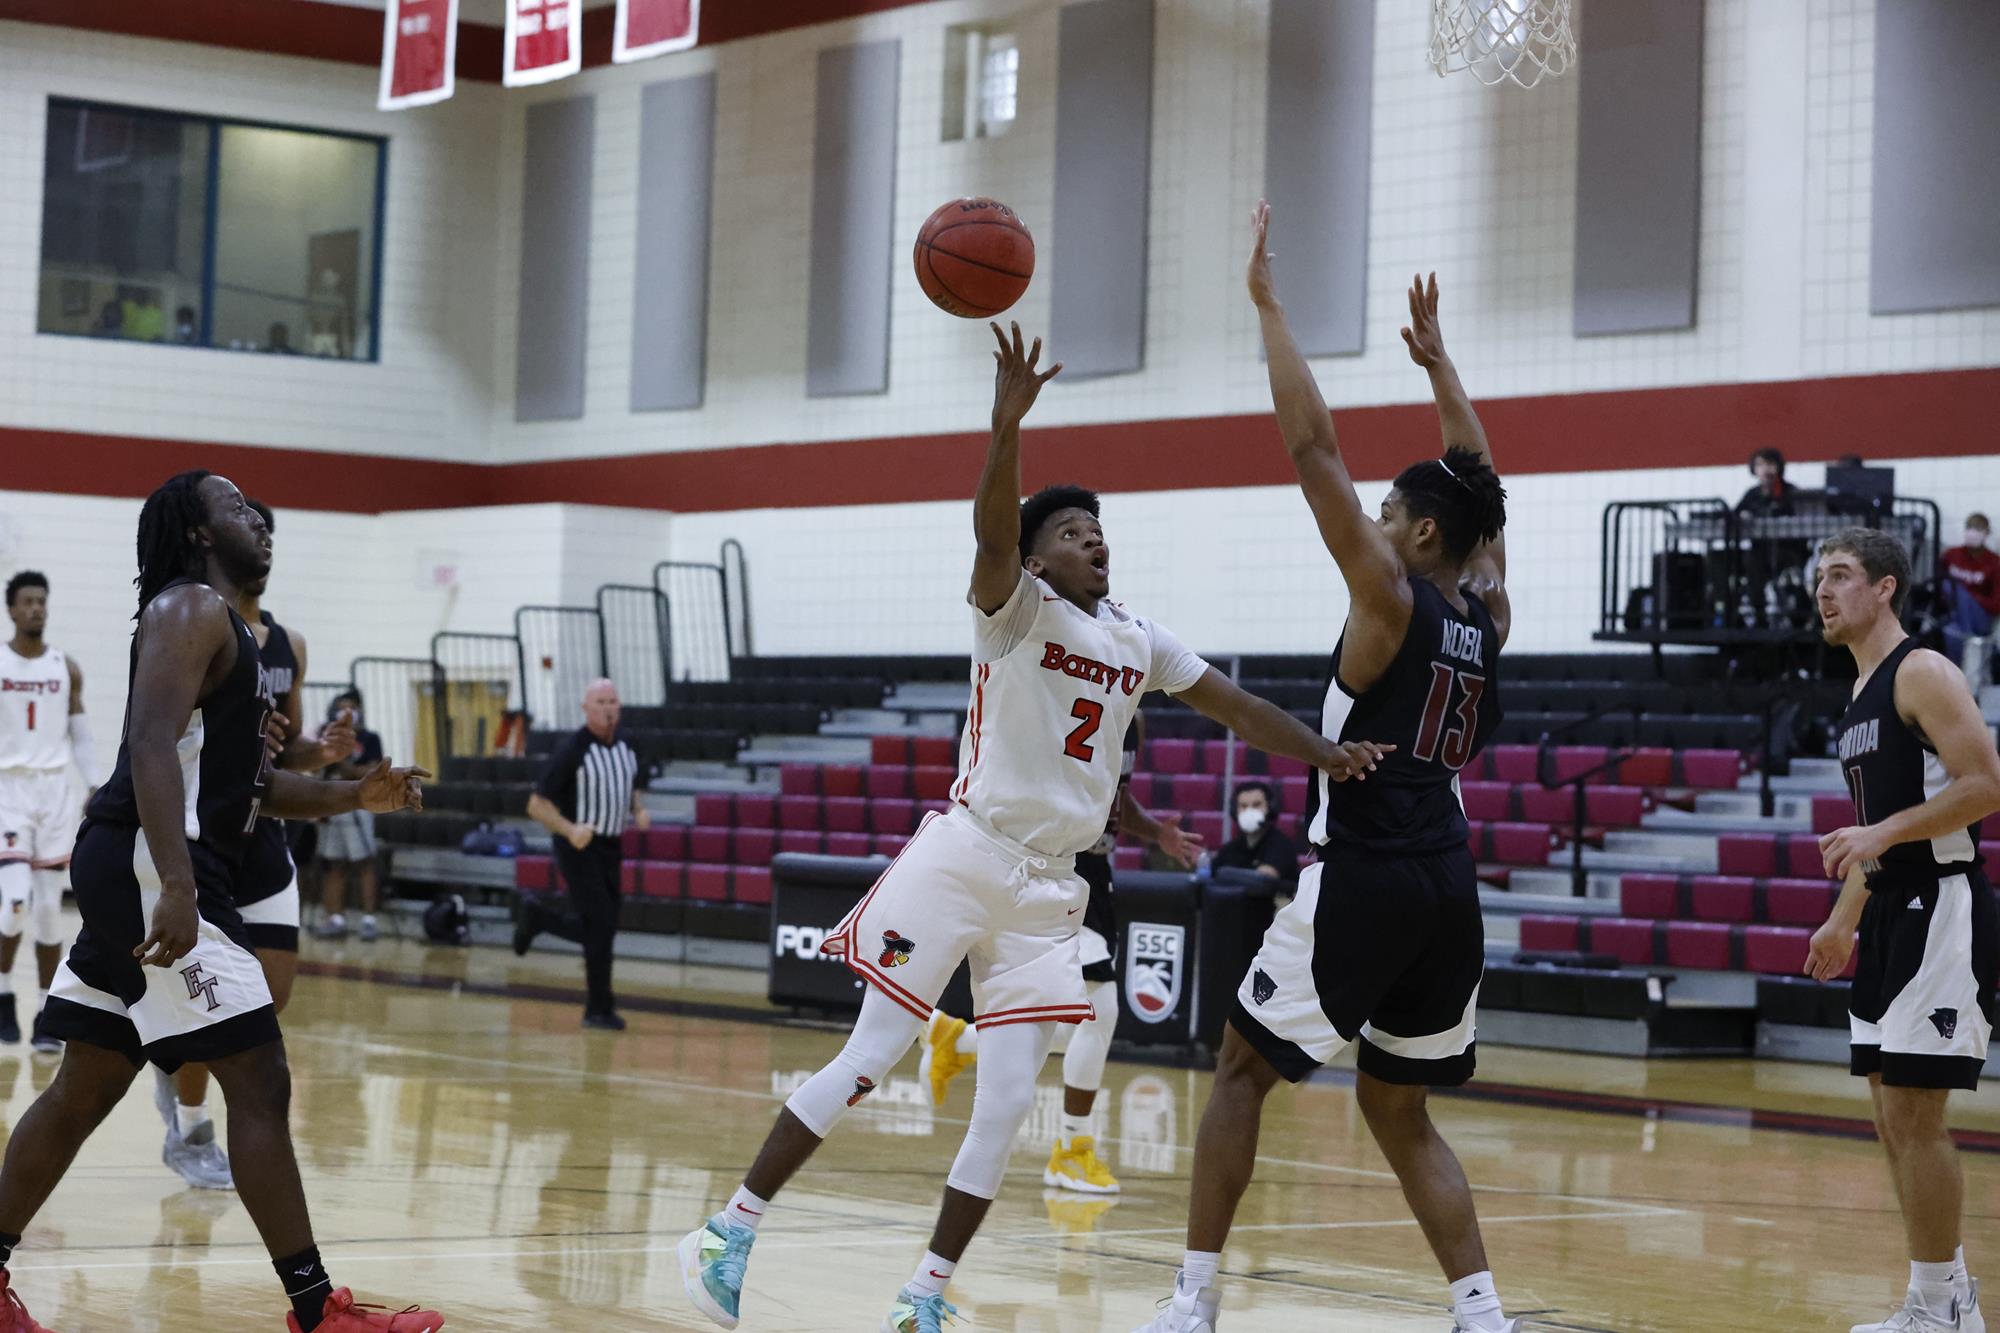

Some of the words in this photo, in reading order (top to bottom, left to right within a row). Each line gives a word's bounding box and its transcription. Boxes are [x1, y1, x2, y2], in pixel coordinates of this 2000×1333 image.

[27, 700, 36, 730] 1
[1063, 697, 1104, 763] 2
[1412, 661, 1486, 771] 13
[1137, 933, 1175, 955] SSC
[179, 961, 221, 1012] FT
